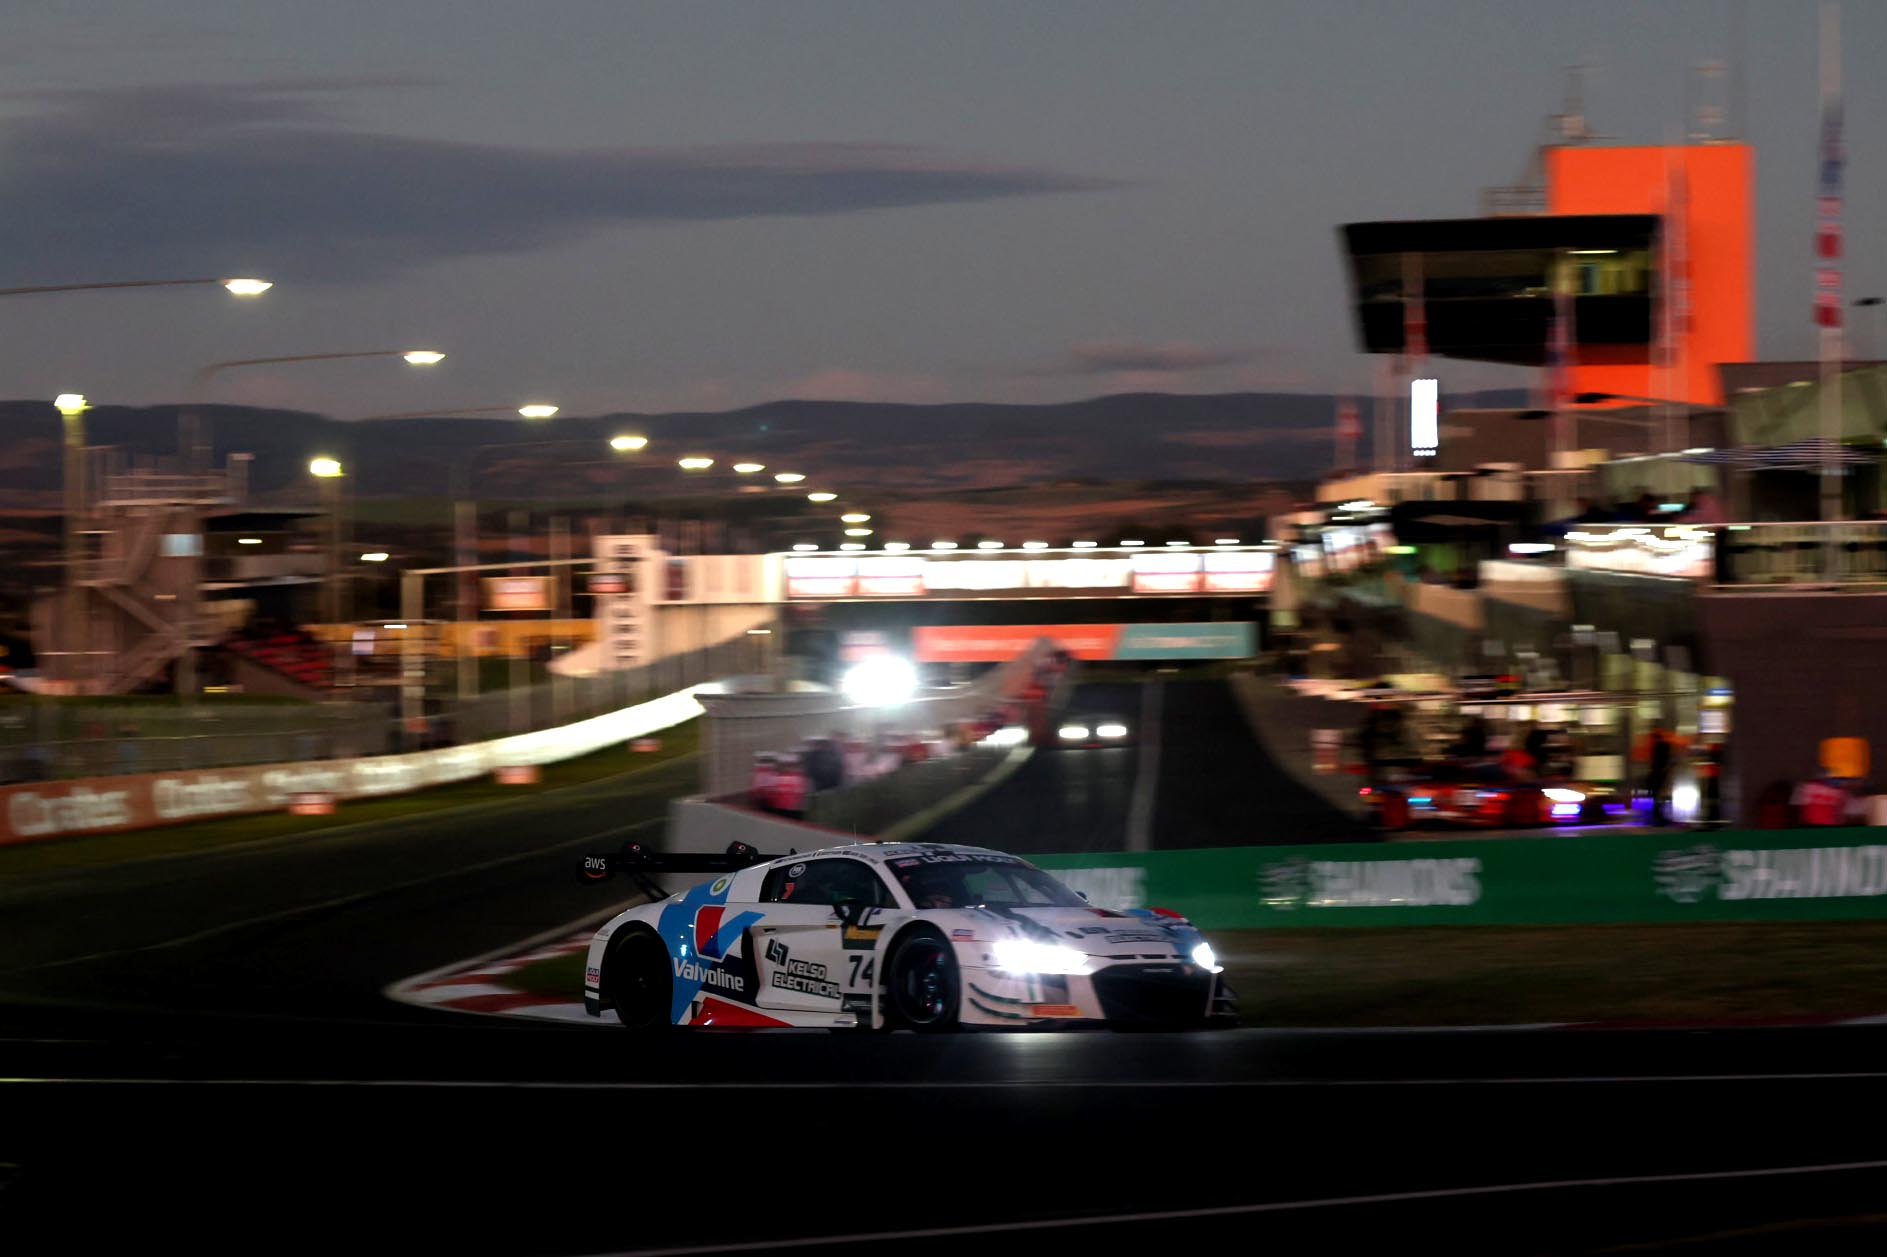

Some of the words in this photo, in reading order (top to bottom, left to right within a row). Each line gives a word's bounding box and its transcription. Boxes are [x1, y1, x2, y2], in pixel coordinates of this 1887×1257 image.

[585, 857, 606, 870] aws
[673, 957, 744, 992] Valvoline
[788, 960, 826, 980] KELSO
[849, 955, 874, 989] 74
[773, 973, 841, 998] ELECTRICAL
